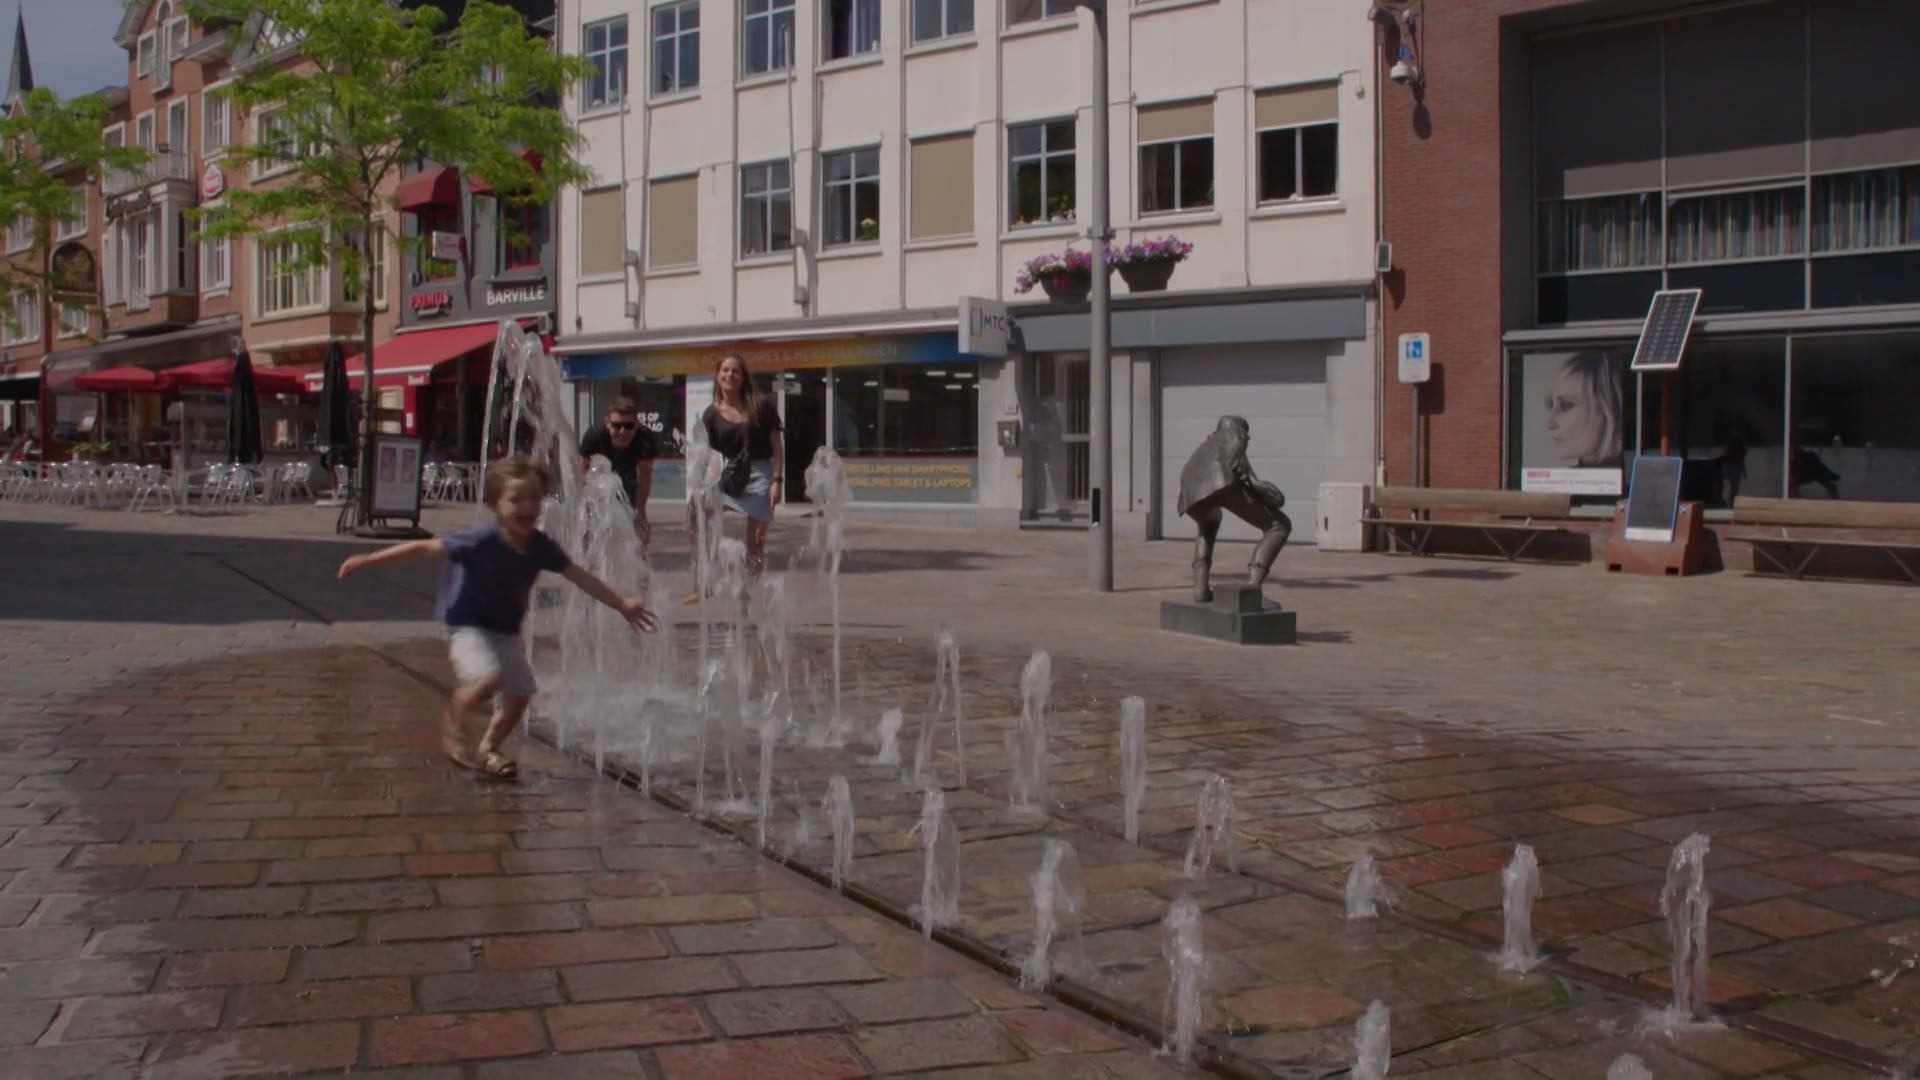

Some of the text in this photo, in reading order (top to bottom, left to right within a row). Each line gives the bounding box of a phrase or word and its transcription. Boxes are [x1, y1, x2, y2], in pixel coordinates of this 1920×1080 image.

[409, 290, 448, 308] PRIMUS
[486, 285, 545, 306] BARVILLE
[984, 314, 1005, 331] MTC
